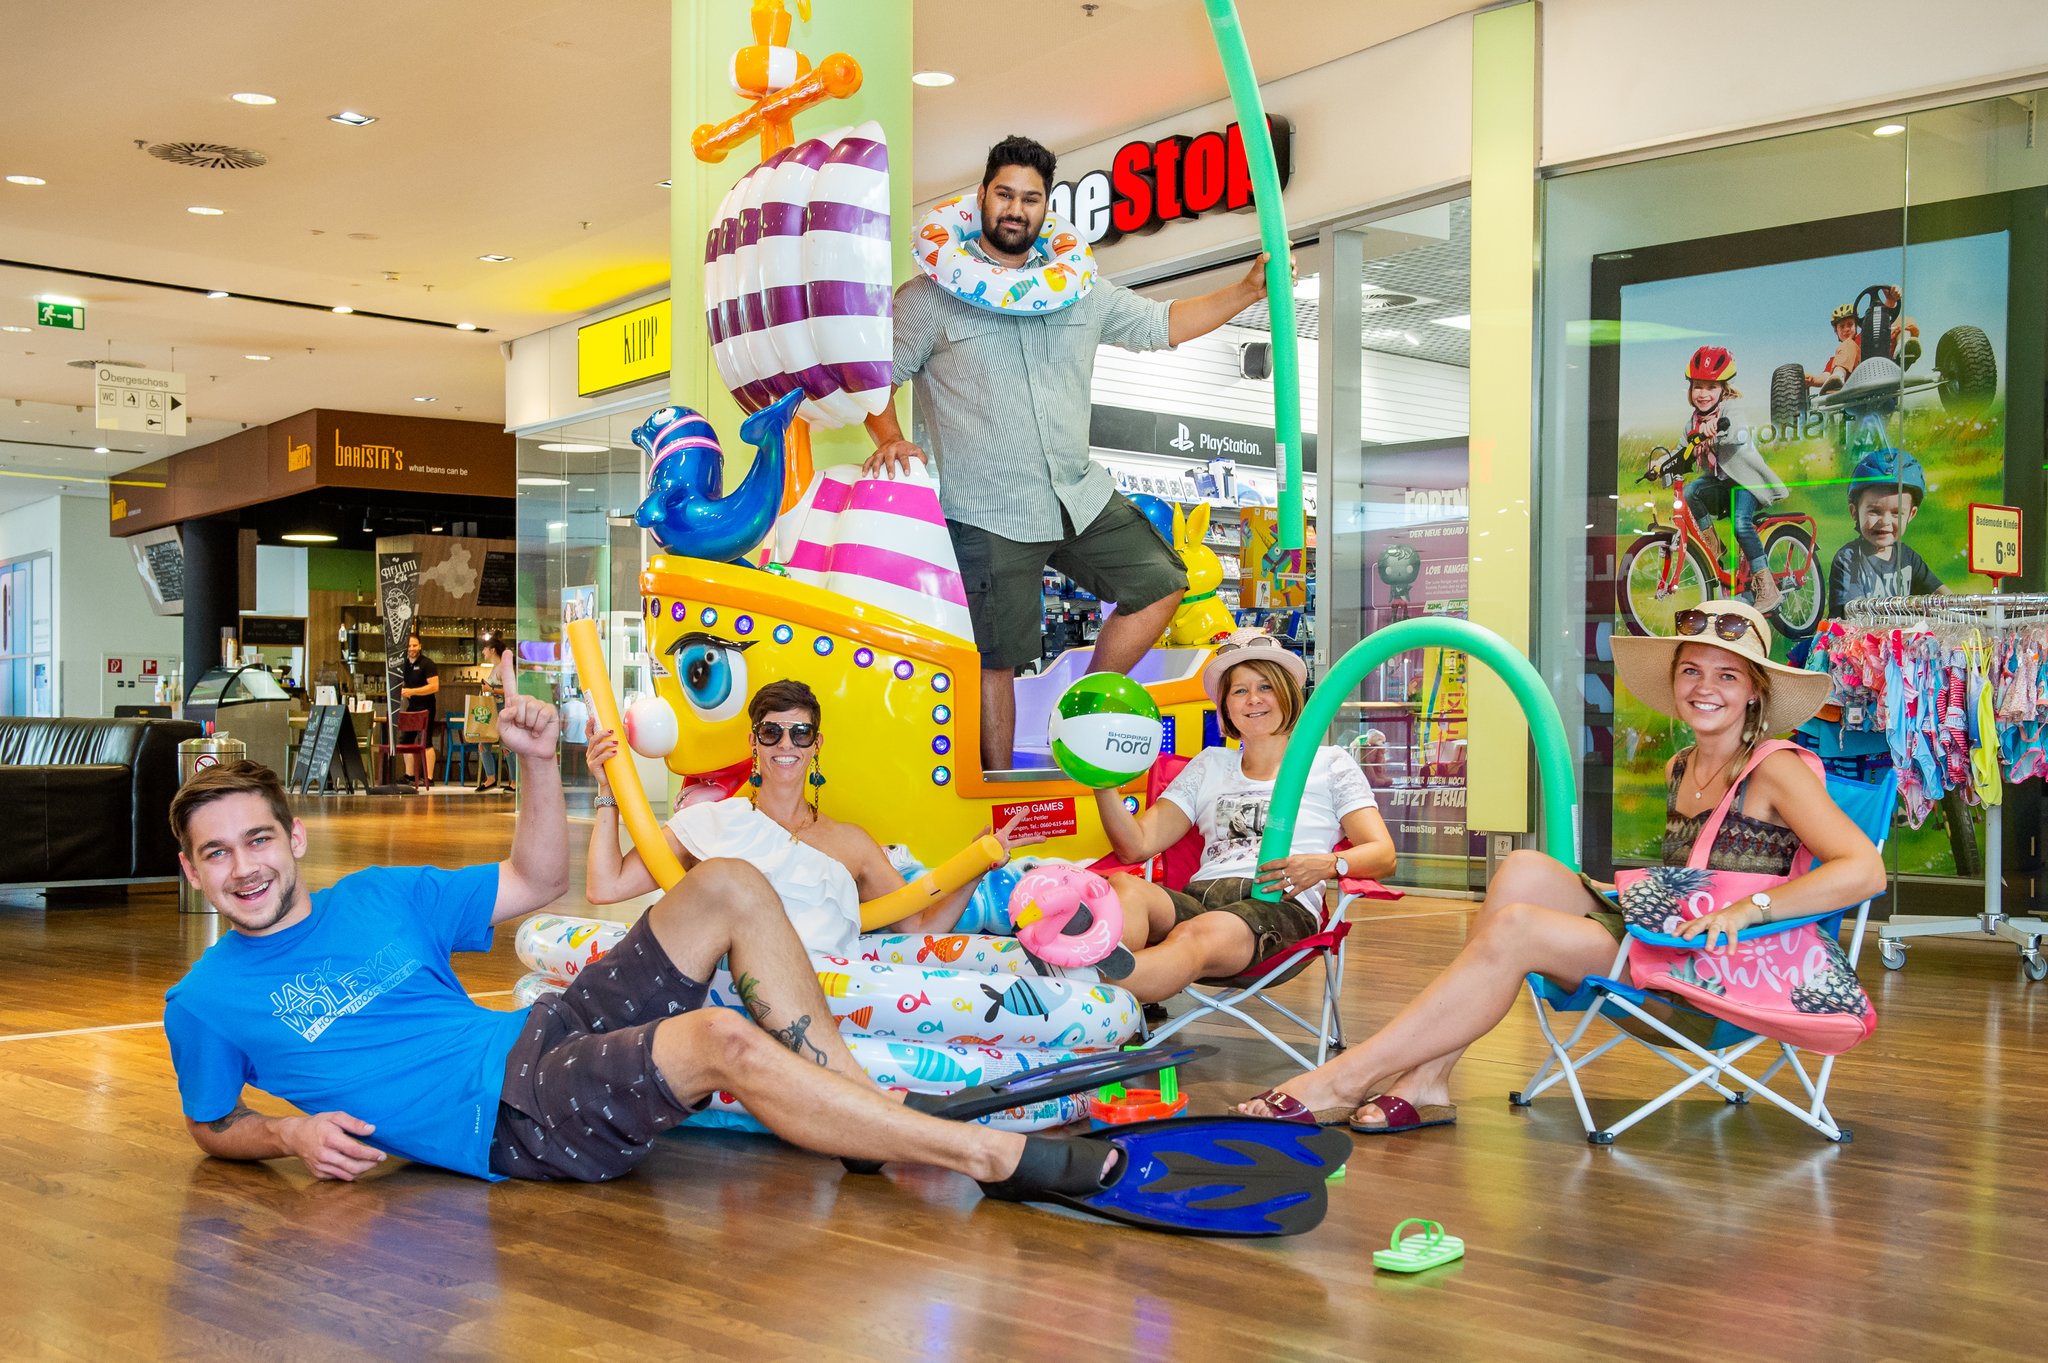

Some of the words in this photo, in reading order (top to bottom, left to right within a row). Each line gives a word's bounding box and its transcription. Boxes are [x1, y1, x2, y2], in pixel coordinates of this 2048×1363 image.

[624, 316, 658, 365] KLIPP
[99, 368, 169, 389] Obergeschoss
[102, 392, 114, 402] WC
[408, 464, 425, 473] what
[425, 465, 446, 475] beans
[446, 467, 459, 475] can
[459, 467, 469, 476] be
[1264, 509, 1278, 520] FOR
[1976, 515, 2002, 528] Bademode
[2003, 518, 2018, 530] Kinde
[1409, 530, 1424, 538] DER
[1425, 529, 1441, 537] NEUE
[1442, 527, 1464, 536] SQUAD
[1995, 541, 2016, 565] 6,99
[1108, 731, 1148, 741] SHOPPING
[1105, 736, 1152, 755] nord
[1448, 776, 1465, 785] NOCH
[1390, 789, 1429, 806] JETZT
[1433, 786, 1466, 808] ERHÄ
[1032, 802, 1063, 812] GAMES
[1400, 823, 1437, 835] GameStop
[270, 957, 340, 1017] JACK
[381, 973, 407, 992] SINCE
